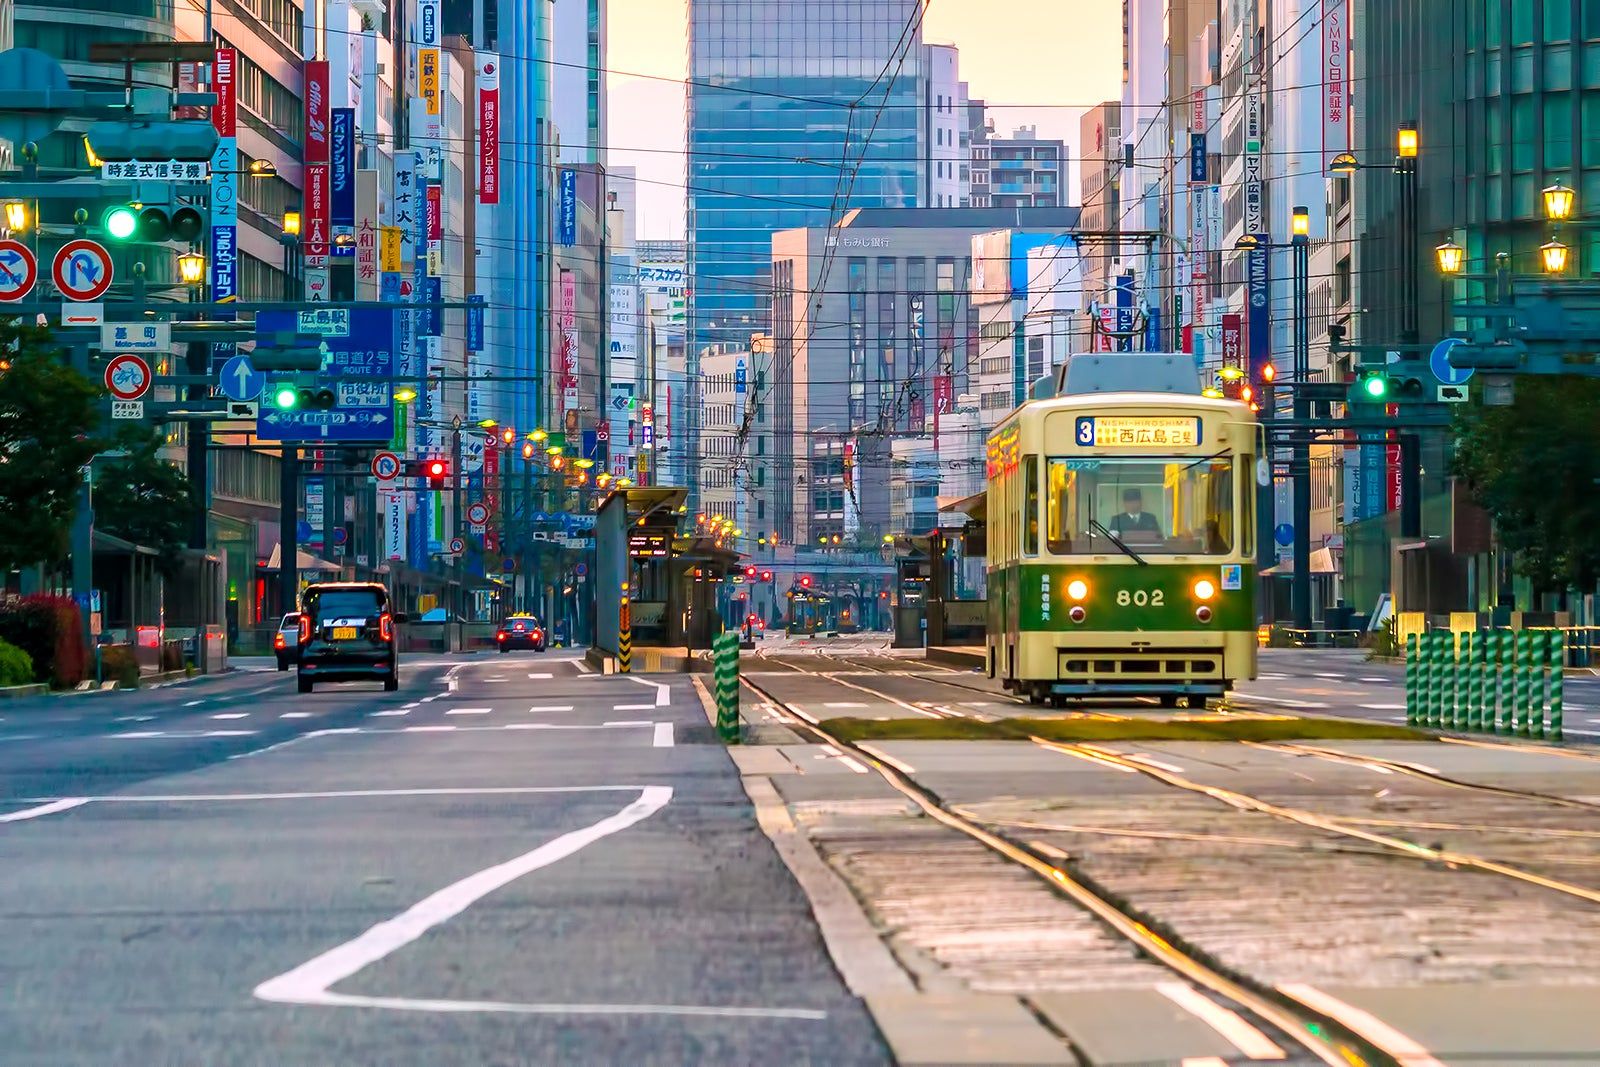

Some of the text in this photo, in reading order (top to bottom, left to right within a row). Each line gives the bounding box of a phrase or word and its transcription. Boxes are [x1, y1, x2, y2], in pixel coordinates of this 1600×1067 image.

[425, 8, 433, 40] Berlitz
[217, 52, 231, 84] LEC
[1329, 12, 1341, 122] SMBC日興証券
[309, 80, 322, 115] Office
[334, 114, 345, 190] アパマンショップ
[484, 101, 495, 193] 損保ジャパン日本興亜
[108, 165, 201, 178] 時差式信号機
[216, 147, 233, 215] KUMON
[359, 218, 375, 278] 大和証券
[843, 237, 889, 248] もみじ銀行
[309, 256, 324, 265] 4F
[301, 309, 347, 324] 広島駅
[115, 327, 156, 340] 基町
[335, 352, 390, 365] 国道2号
[343, 366, 382, 374] ROUTE 2
[345, 396, 360, 405] City
[1101, 419, 1191, 427] NISHI-HIROSHIMA
[1080, 421, 1093, 443] 3
[1120, 428, 1167, 443] 西広島
[1067, 461, 1100, 470] ワンマン
[1116, 589, 1165, 607] 802
